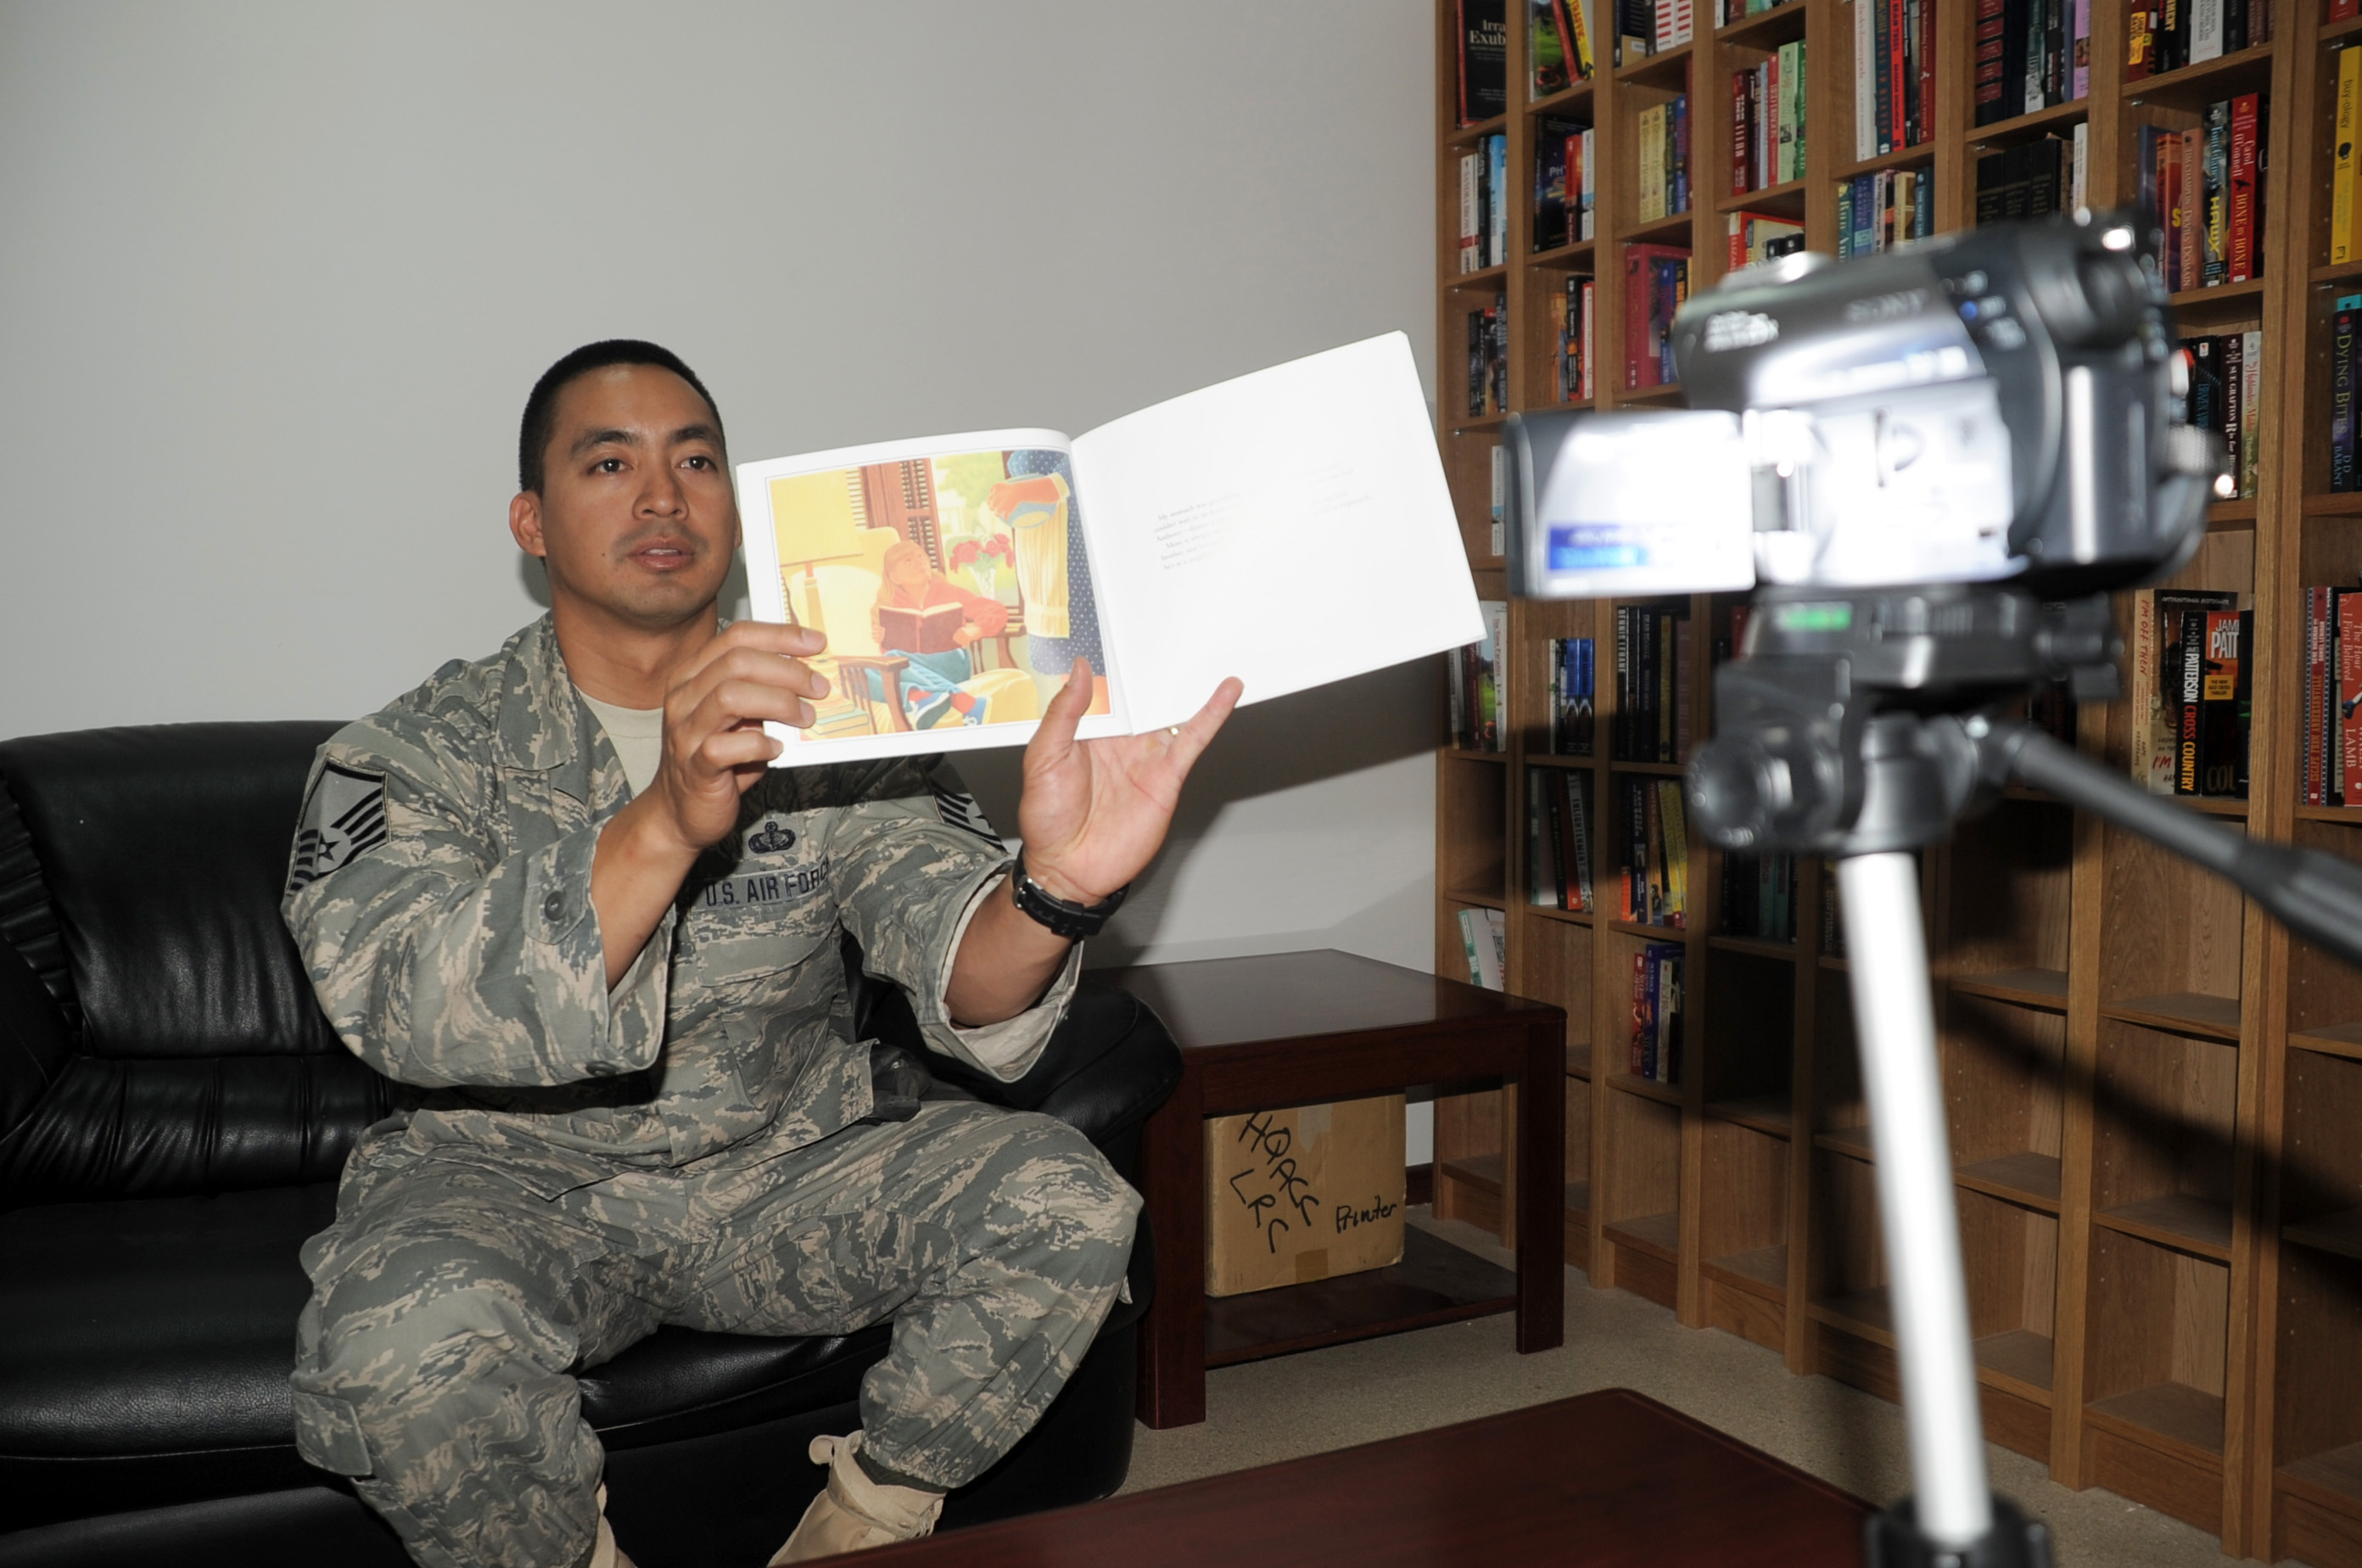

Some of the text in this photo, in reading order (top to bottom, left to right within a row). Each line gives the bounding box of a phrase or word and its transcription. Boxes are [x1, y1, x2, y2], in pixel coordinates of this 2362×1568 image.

[1469, 30, 1506, 45] Exub
[2210, 126, 2224, 148] Tom
[2231, 133, 2245, 176] O'Connell
[2242, 140, 2255, 165] Carol
[1839, 200, 1851, 230] Run
[2208, 196, 2220, 253] HAWX
[2234, 193, 2248, 227] BONE
[2182, 245, 2193, 287] DOMAIN
[2233, 238, 2247, 271] BONE
[2229, 366, 2237, 382] SUE
[2336, 333, 2353, 434] DYING BITES
[2228, 384, 2237, 422] GRAFTON
[2225, 423, 2237, 433] R
[2333, 445, 2343, 486] BARANT
[2342, 454, 2352, 463] D
[1618, 609, 1626, 640] DENNIS
[2139, 599, 2150, 676] I'M OFF THEN
[2342, 620, 2353, 642] First
[2183, 653, 2200, 703] PATTERSON
[2342, 644, 2354, 681] Believed
[2183, 705, 2197, 740] CROSS
[2310, 675, 2322, 781] ESCAPE FROM ANDERSONVILLE
[2152, 754, 2172, 770] I'M
[2180, 741, 2196, 792] COUNTRY
[2345, 729, 2357, 770] LAMB
[1571, 798, 1586, 866] ENLIGHTENMENT
[706, 880, 740, 908] U.S.
[747, 876, 780, 904] AIR
[1336, 1195, 1397, 1234] Printer
